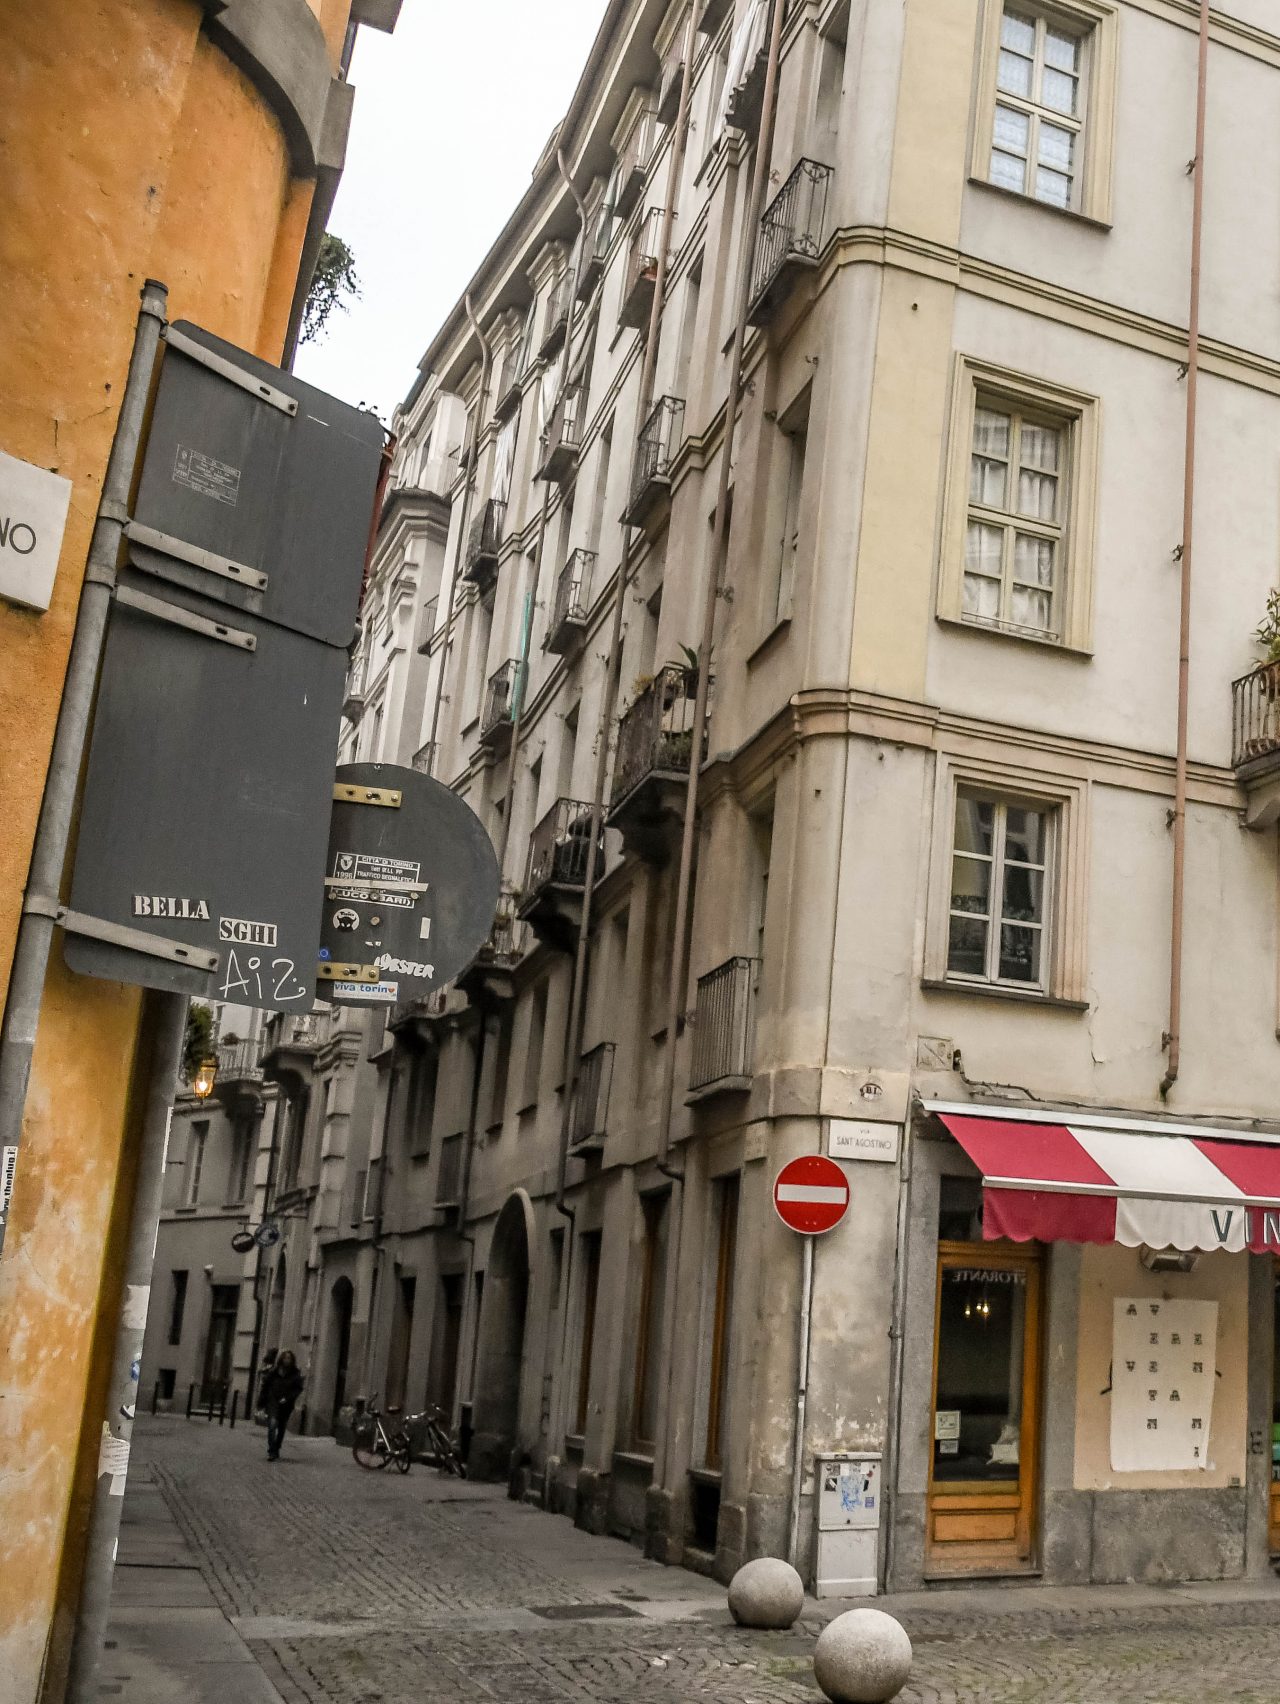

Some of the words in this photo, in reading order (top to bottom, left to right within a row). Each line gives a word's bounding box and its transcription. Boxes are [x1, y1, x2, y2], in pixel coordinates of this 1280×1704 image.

[134, 895, 210, 919] BELLA
[220, 920, 276, 945] SGHI
[335, 983, 356, 991] viva
